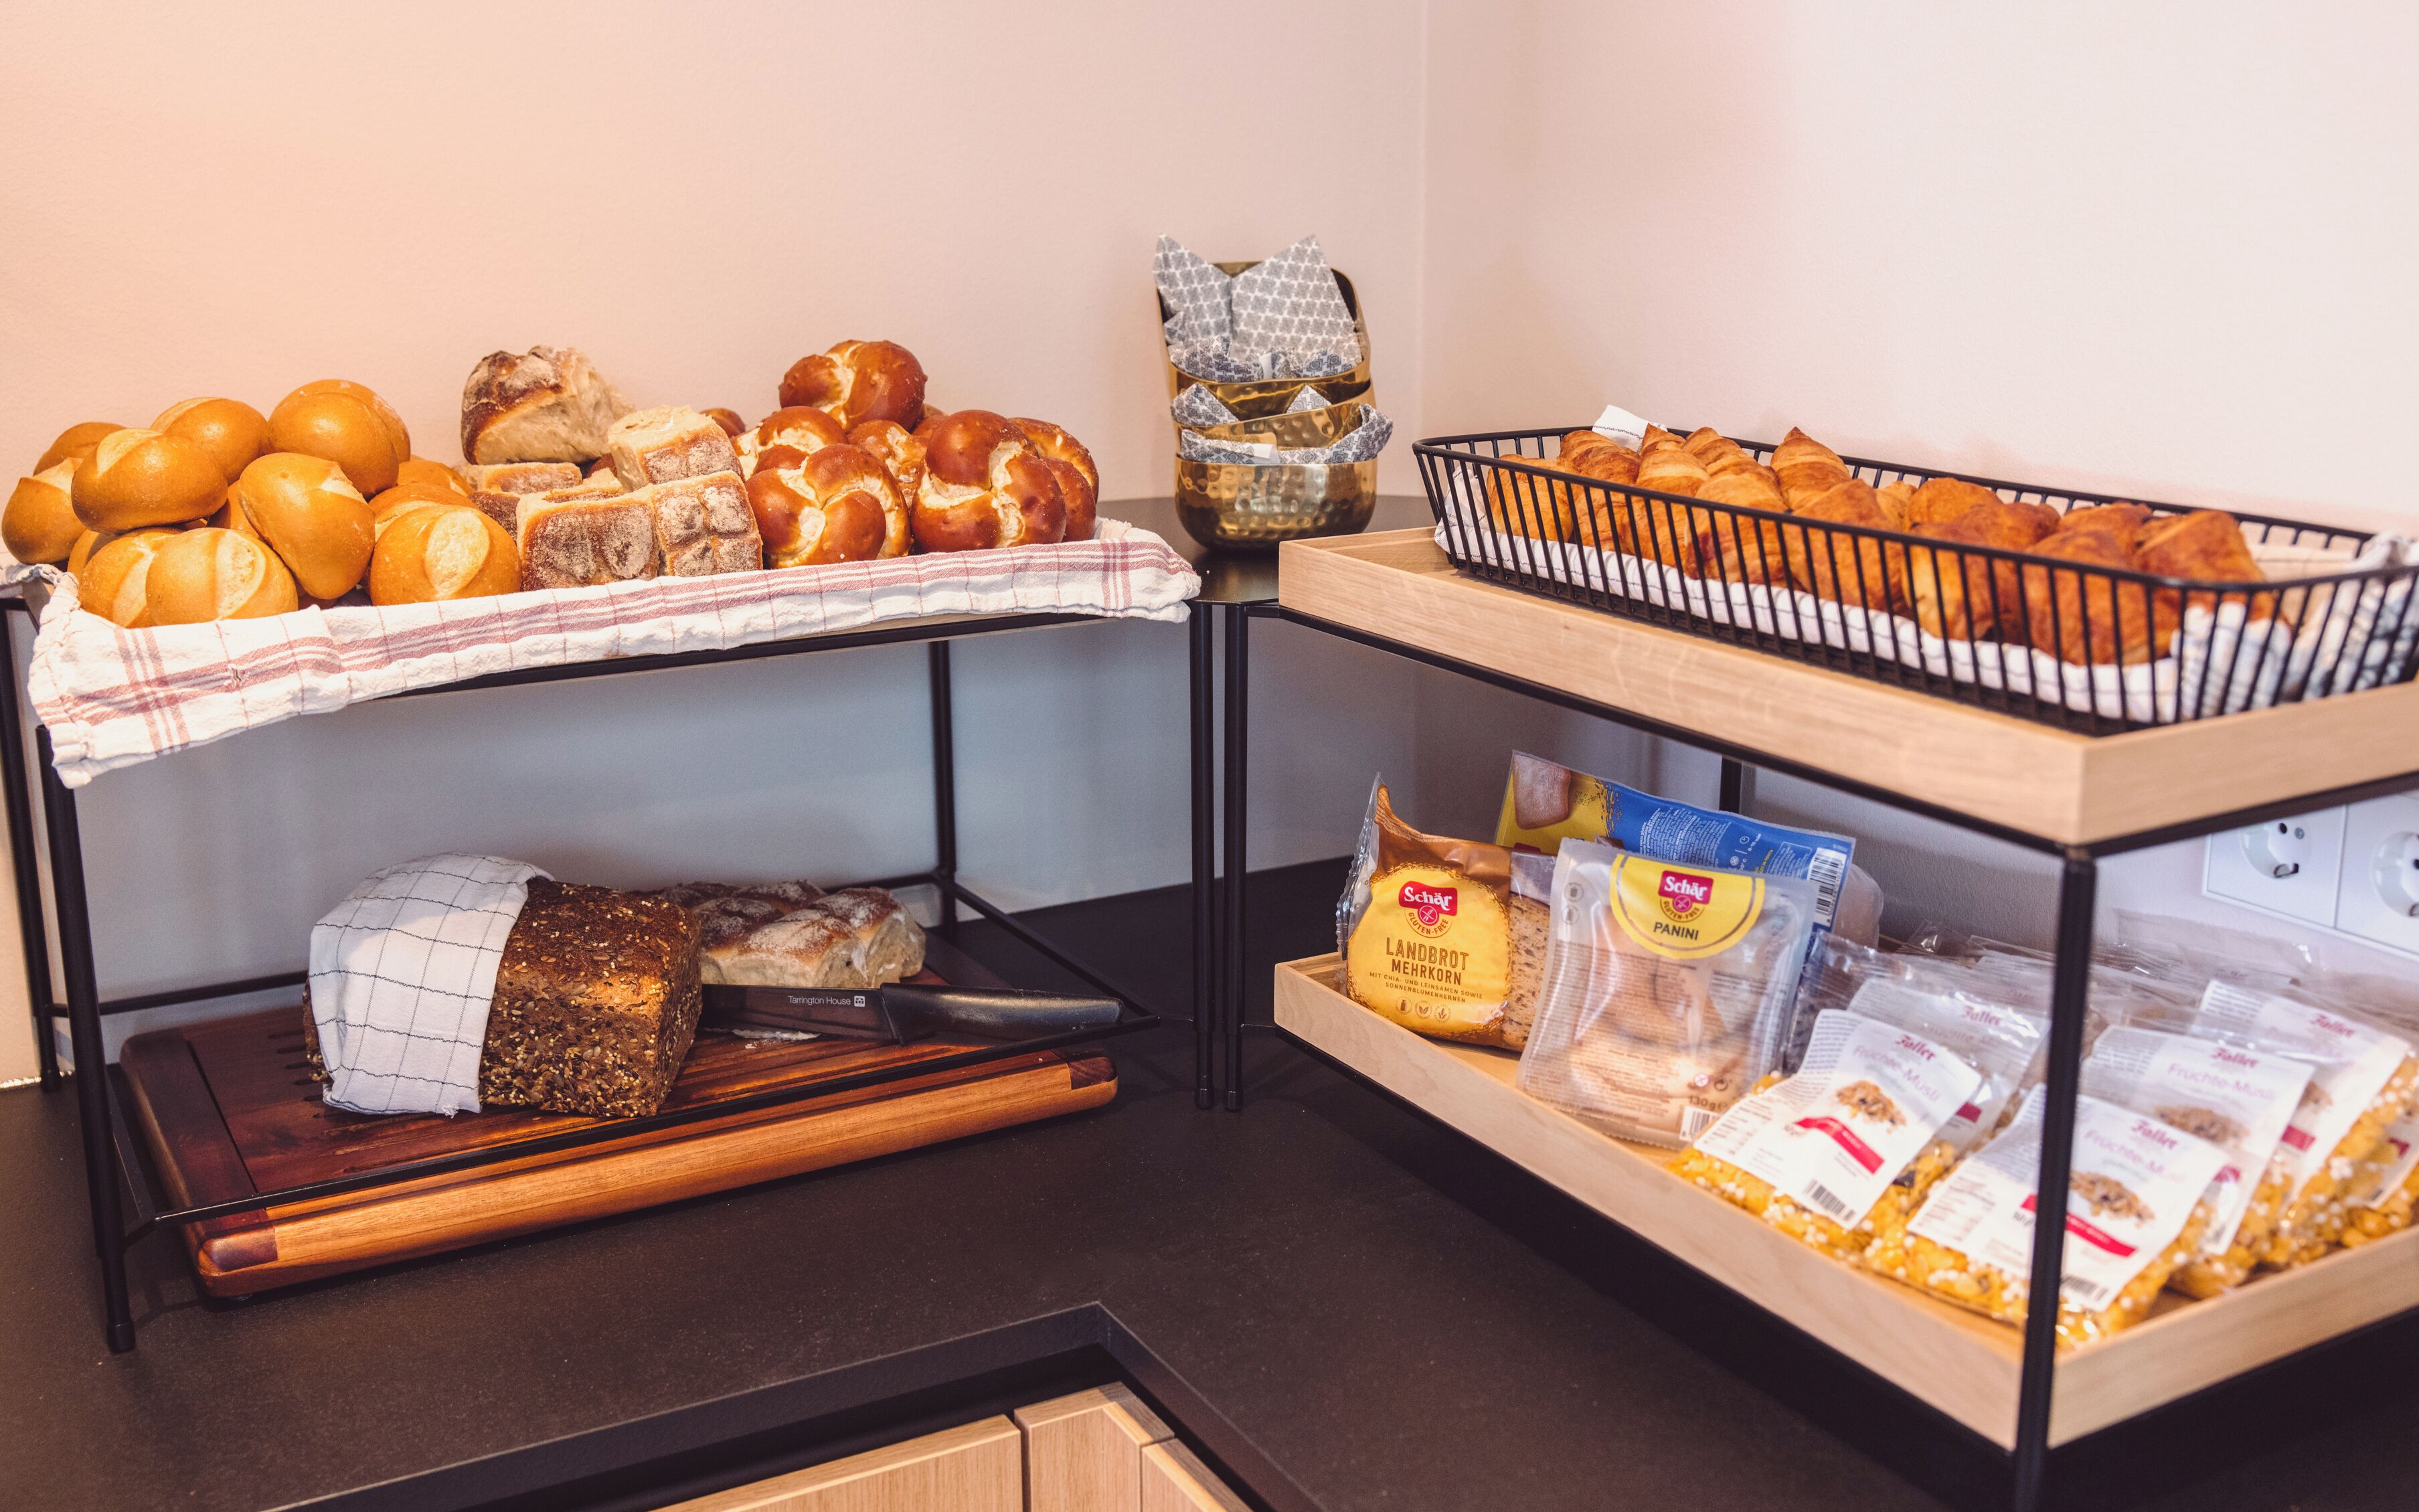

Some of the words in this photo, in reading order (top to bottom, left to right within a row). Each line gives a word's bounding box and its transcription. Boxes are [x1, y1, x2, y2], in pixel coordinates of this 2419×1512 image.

[1404, 886, 1452, 911] Schär
[1664, 875, 1707, 901] Schär
[1663, 900, 1700, 920] GLUTEN-FREE
[1408, 912, 1449, 935] GLUTEN-FREE
[1653, 922, 1699, 940] PANINI
[1386, 937, 1469, 970] LANDBROT
[1392, 958, 1461, 986] MEHRKORN
[1384, 975, 1402, 983] CHIA-
[1420, 982, 1458, 994] LEINSAMEN
[1461, 990, 1483, 999] SOWIE
[1385, 982, 1466, 1003] SONNENBLUMENKERNEN
[788, 996, 825, 1005] Tarrington
[826, 997, 851, 1005] House
